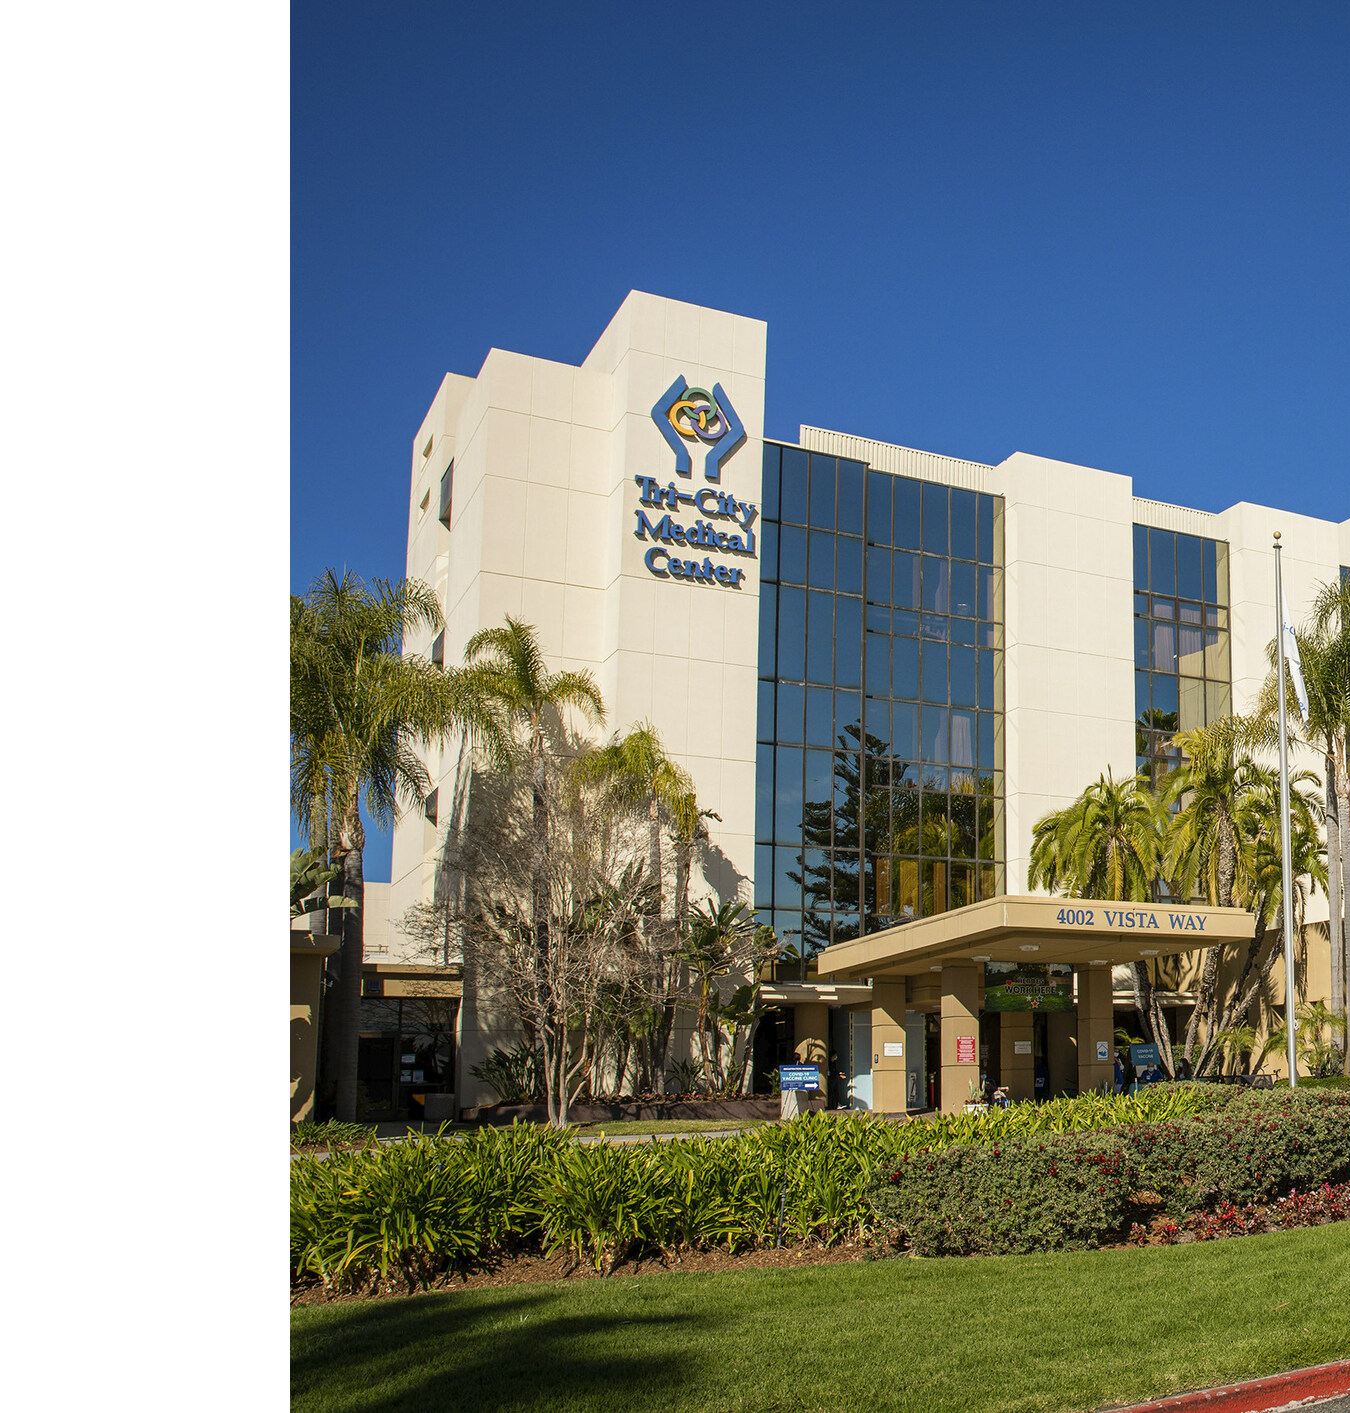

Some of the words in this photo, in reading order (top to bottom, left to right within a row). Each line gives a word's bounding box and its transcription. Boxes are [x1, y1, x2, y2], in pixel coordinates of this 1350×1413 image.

[635, 474, 756, 526] Tri-City
[633, 509, 755, 553] Medical
[644, 547, 744, 584] Center
[1056, 908, 1095, 926] 4002
[1104, 910, 1160, 929] VISTA
[1168, 913, 1208, 931] WAY
[1005, 985, 1032, 994] WORK
[1034, 986, 1056, 994] HERE
